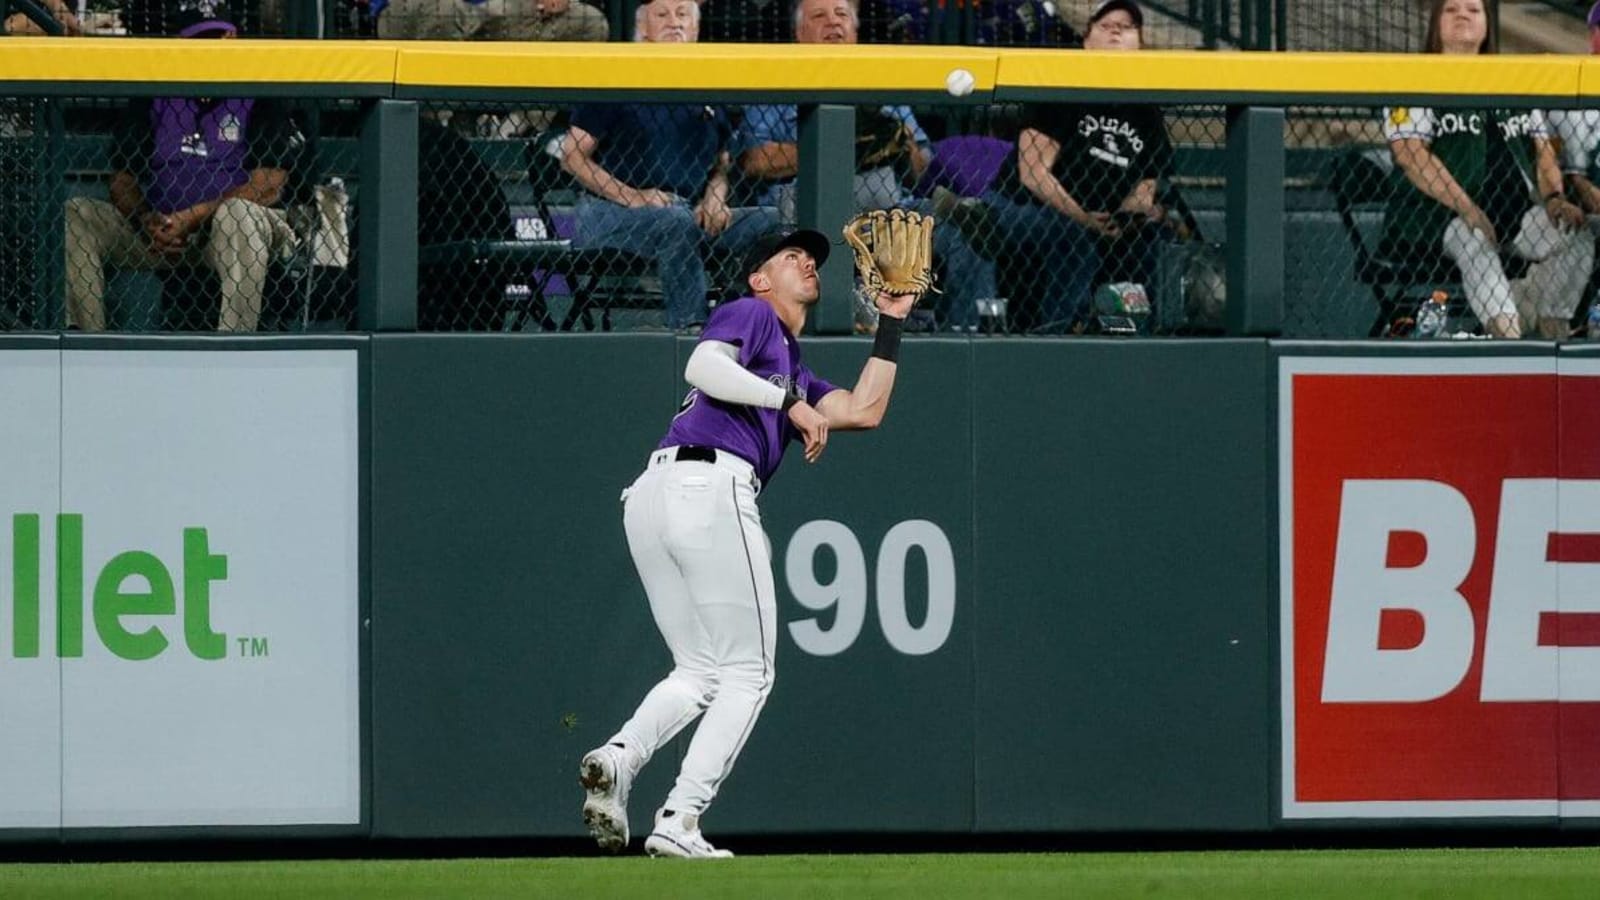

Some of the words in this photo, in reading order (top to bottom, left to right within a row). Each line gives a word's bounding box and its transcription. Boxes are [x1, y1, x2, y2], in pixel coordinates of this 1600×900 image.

[13, 513, 228, 661] llet
[236, 637, 270, 657] TM
[764, 518, 957, 657] 90
[1321, 477, 1600, 703] BE
